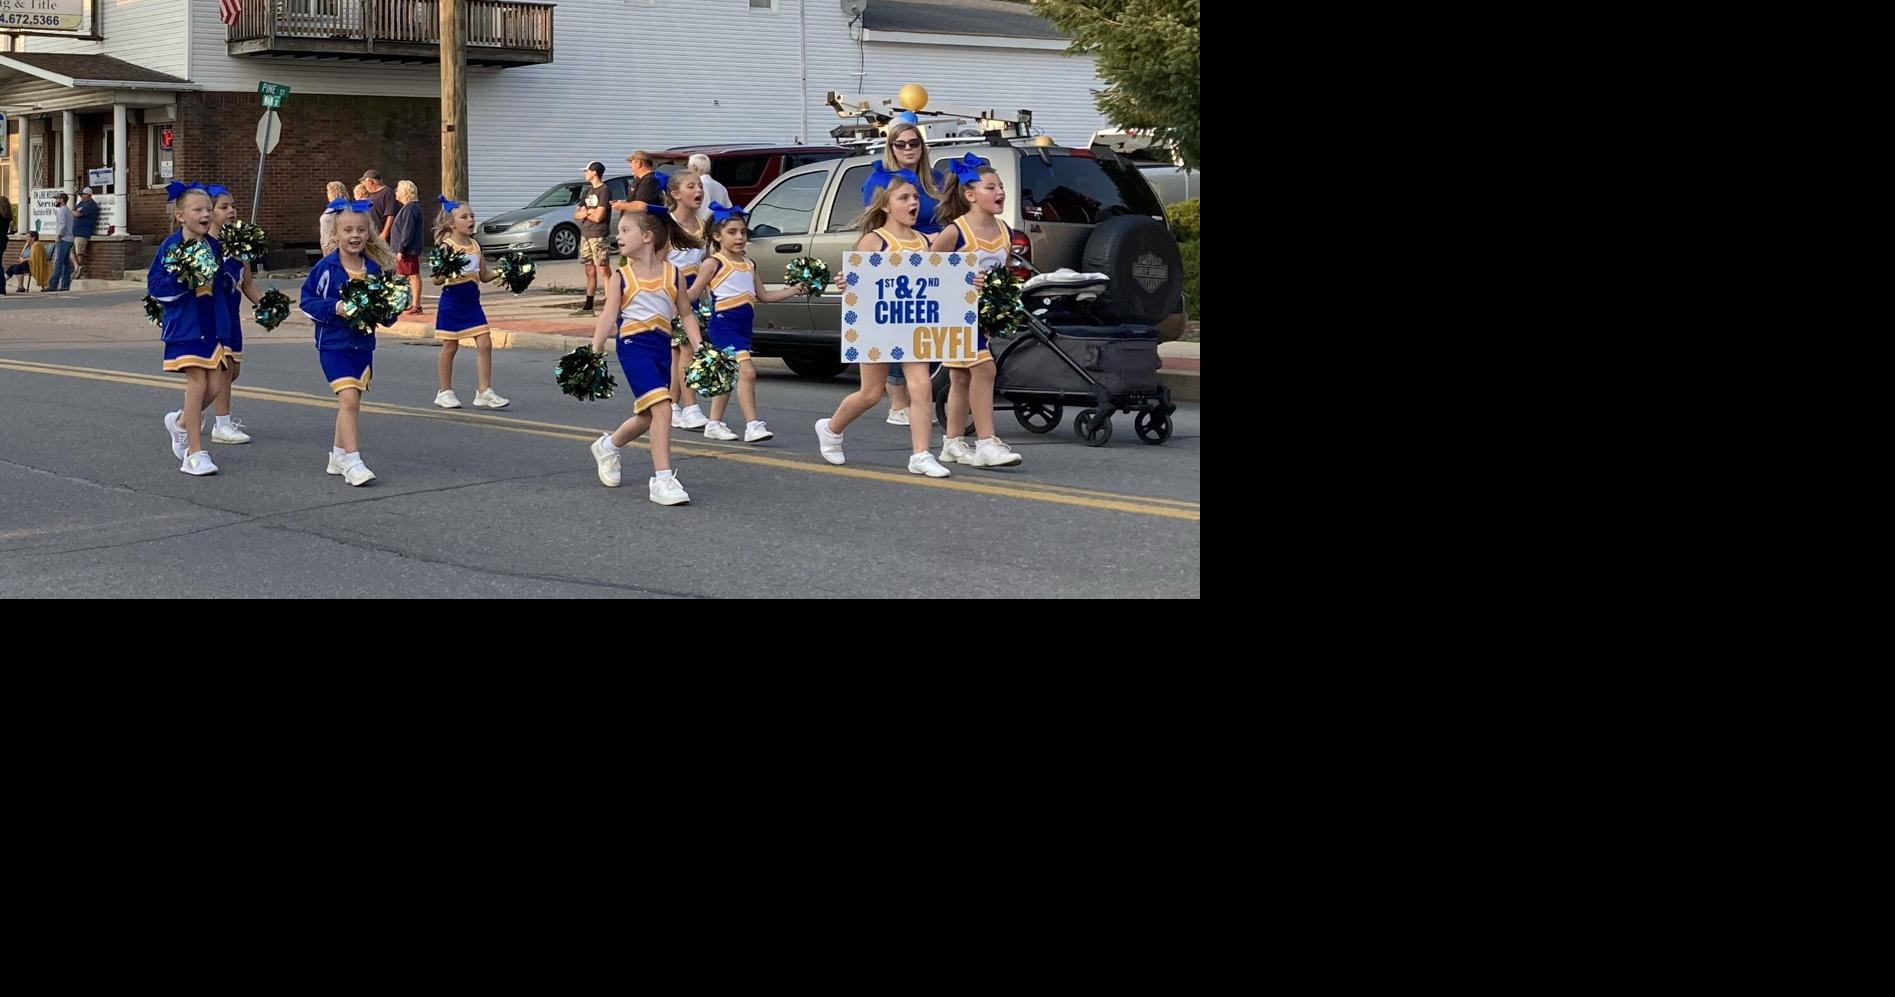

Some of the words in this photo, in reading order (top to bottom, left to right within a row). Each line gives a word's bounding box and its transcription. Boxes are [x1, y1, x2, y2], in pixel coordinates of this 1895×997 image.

[15, 0, 24, 8] &
[31, 0, 57, 10] Title
[0, 13, 60, 25] 4.672.5366
[37, 200, 57, 208] Servic
[874, 277, 896, 300] 1ST
[894, 274, 913, 300] &
[915, 277, 940, 300] 2ND
[874, 300, 940, 325] CHEER
[912, 326, 976, 360] GYFL
